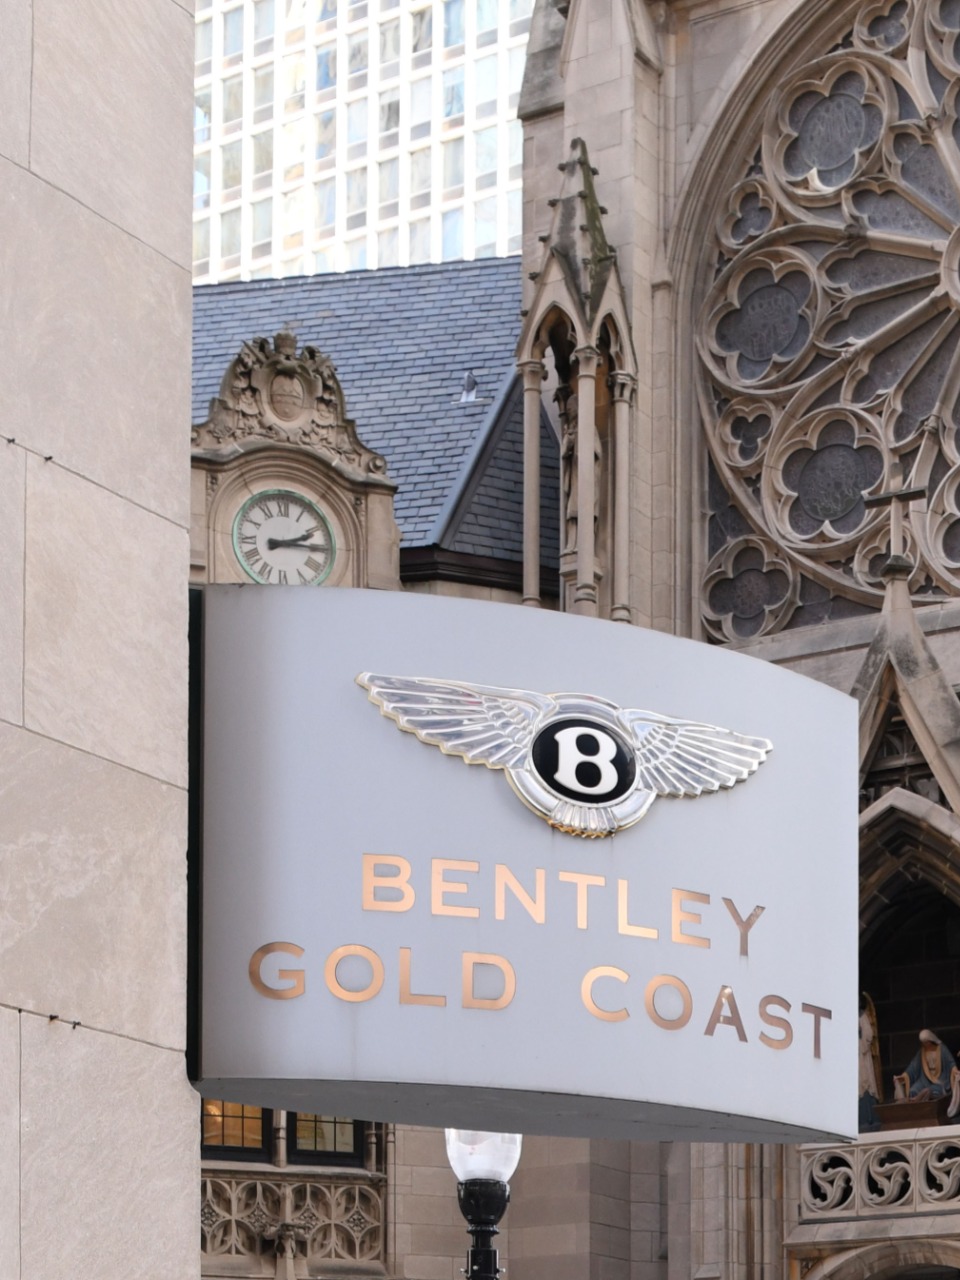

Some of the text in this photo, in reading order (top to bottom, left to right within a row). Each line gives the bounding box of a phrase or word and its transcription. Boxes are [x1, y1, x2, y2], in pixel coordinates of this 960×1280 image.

[258, 502, 274, 520] XI
[277, 500, 290, 518] XII
[245, 518, 261, 530] X
[241, 535, 257, 545] IX
[554, 725, 619, 796] B
[361, 853, 767, 957] BENTLEY
[247, 941, 833, 1060] GOLD COAST
